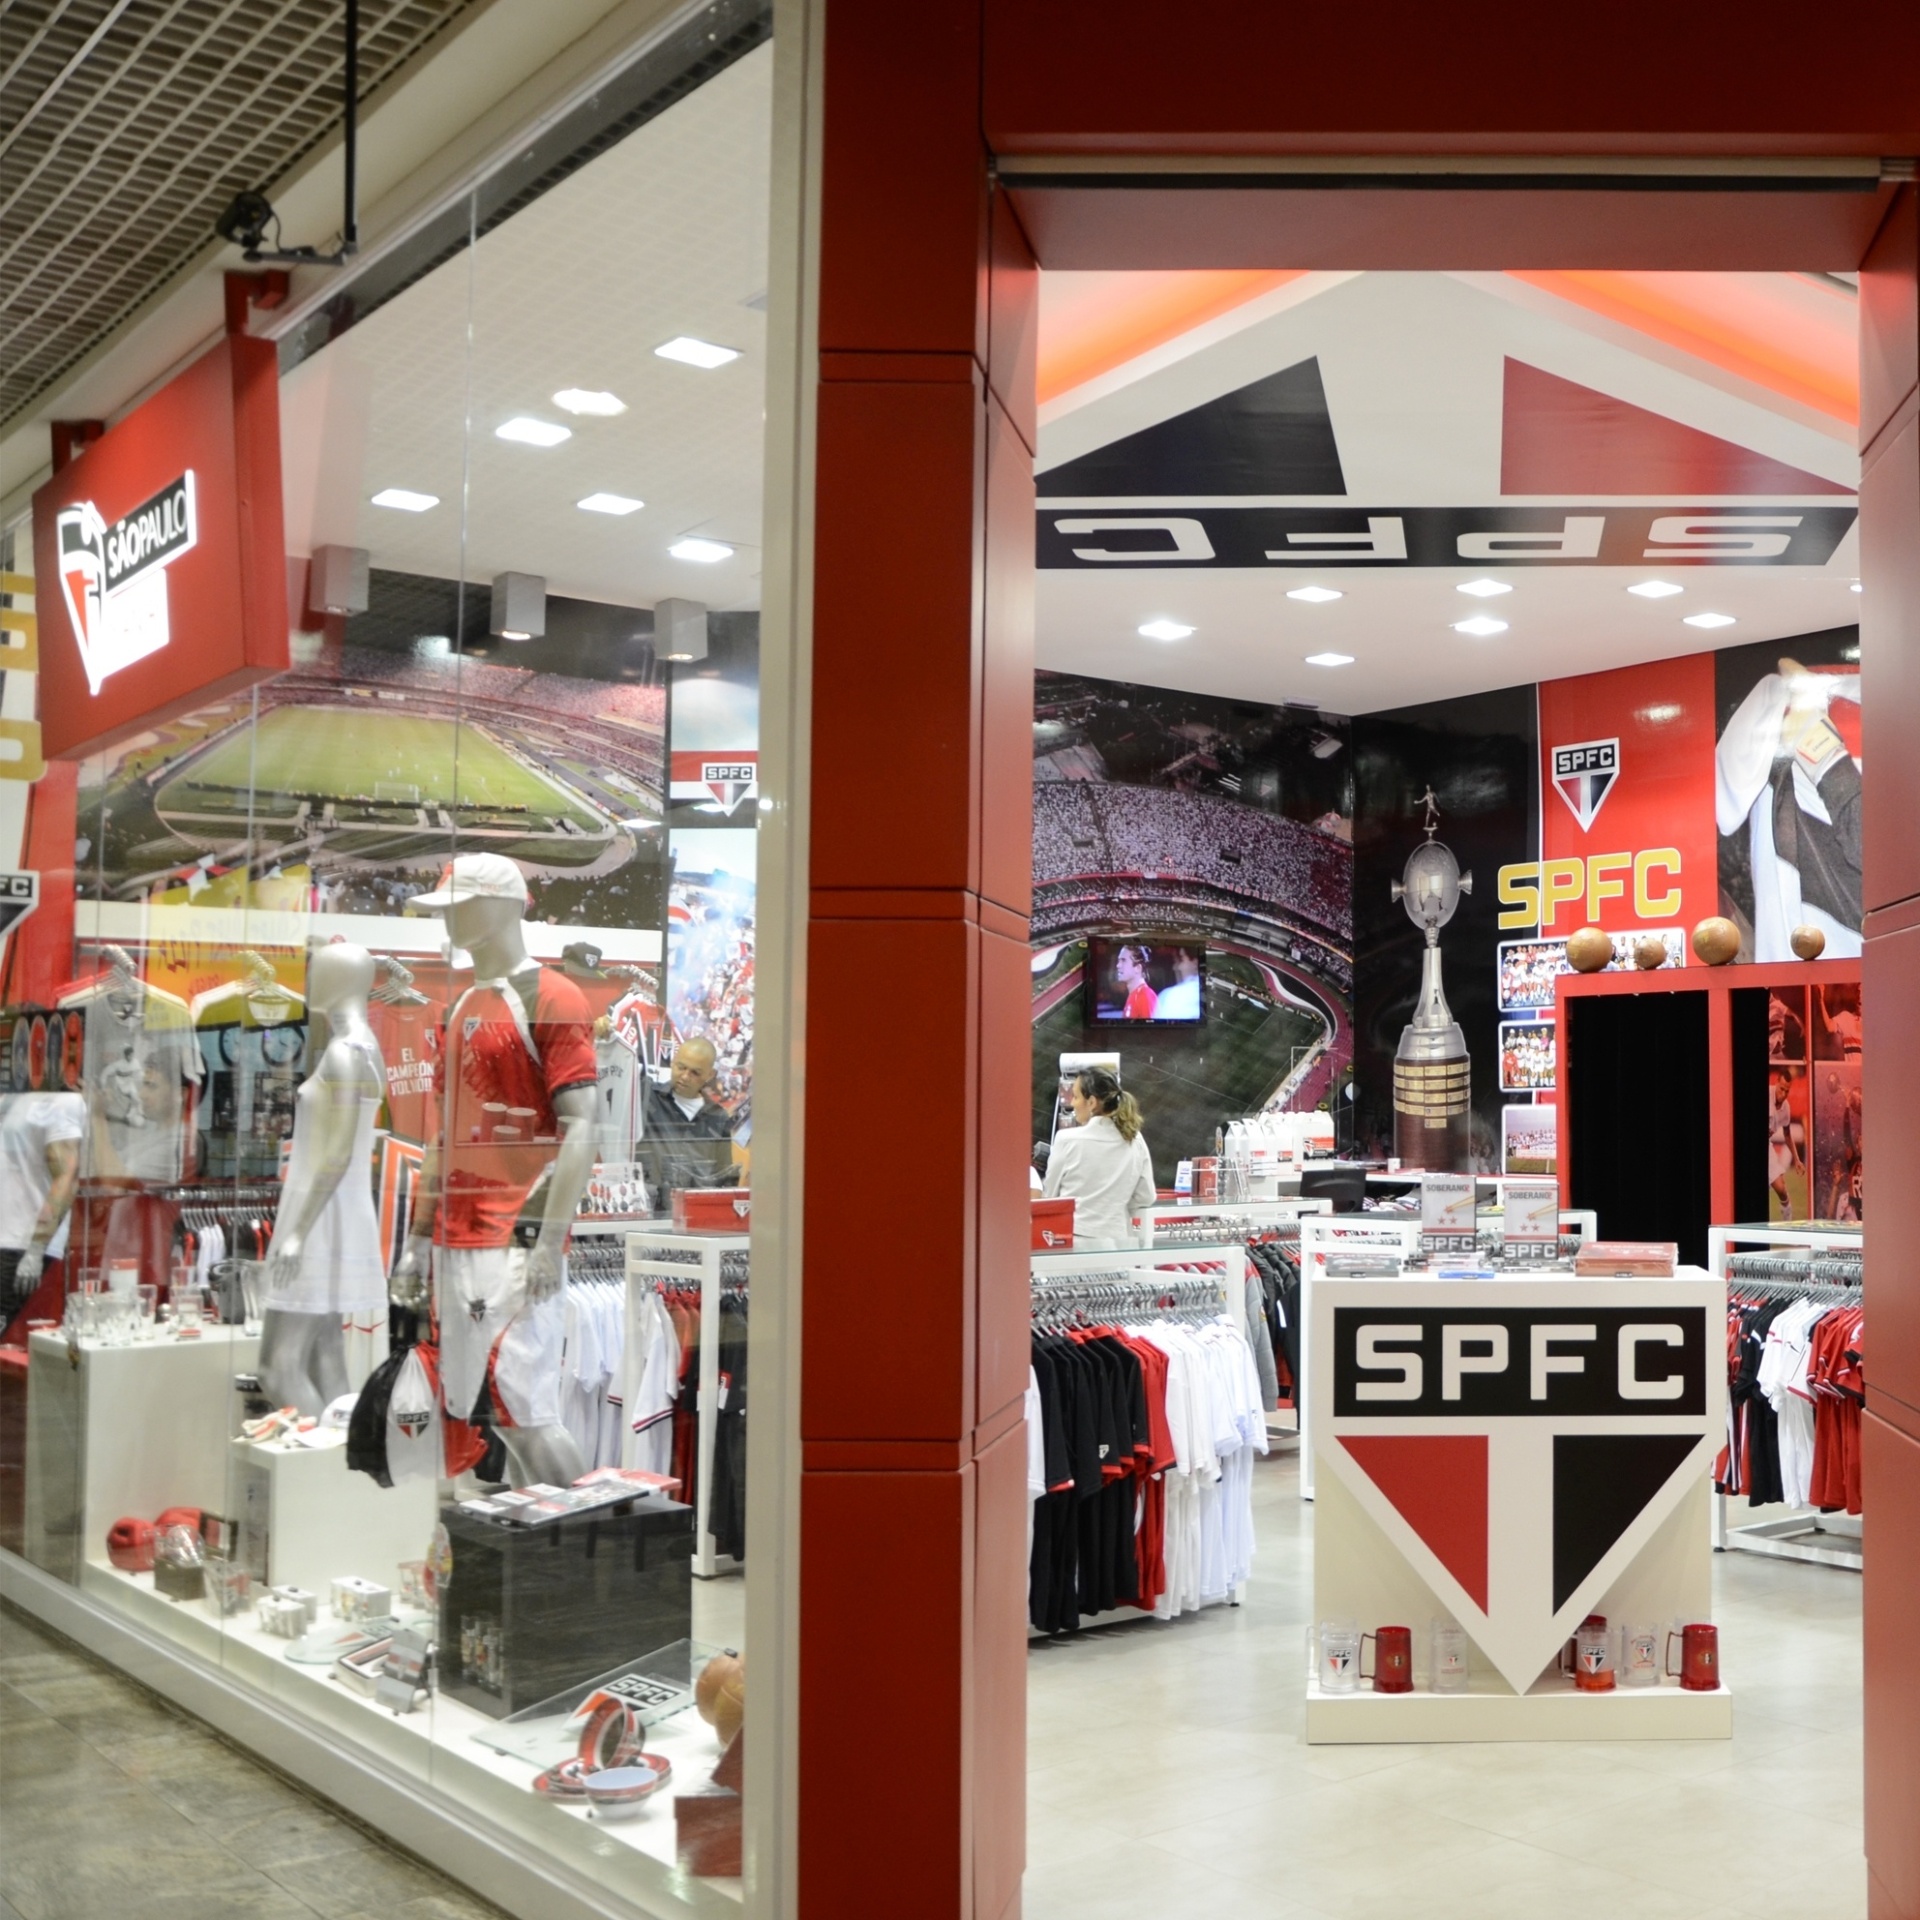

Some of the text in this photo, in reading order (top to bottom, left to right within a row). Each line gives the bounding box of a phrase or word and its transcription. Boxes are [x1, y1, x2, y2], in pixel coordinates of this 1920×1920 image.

[1557, 747, 1613, 773] SPFC
[707, 767, 752, 779] SPFC
[1497, 847, 1682, 930] SPFC
[401, 1047, 415, 1062] EL
[1422, 1236, 1474, 1250] SPFC
[1505, 1244, 1556, 1258] SPFC
[1355, 1324, 1685, 1401] SPFC
[608, 1679, 676, 1704] SPFC
